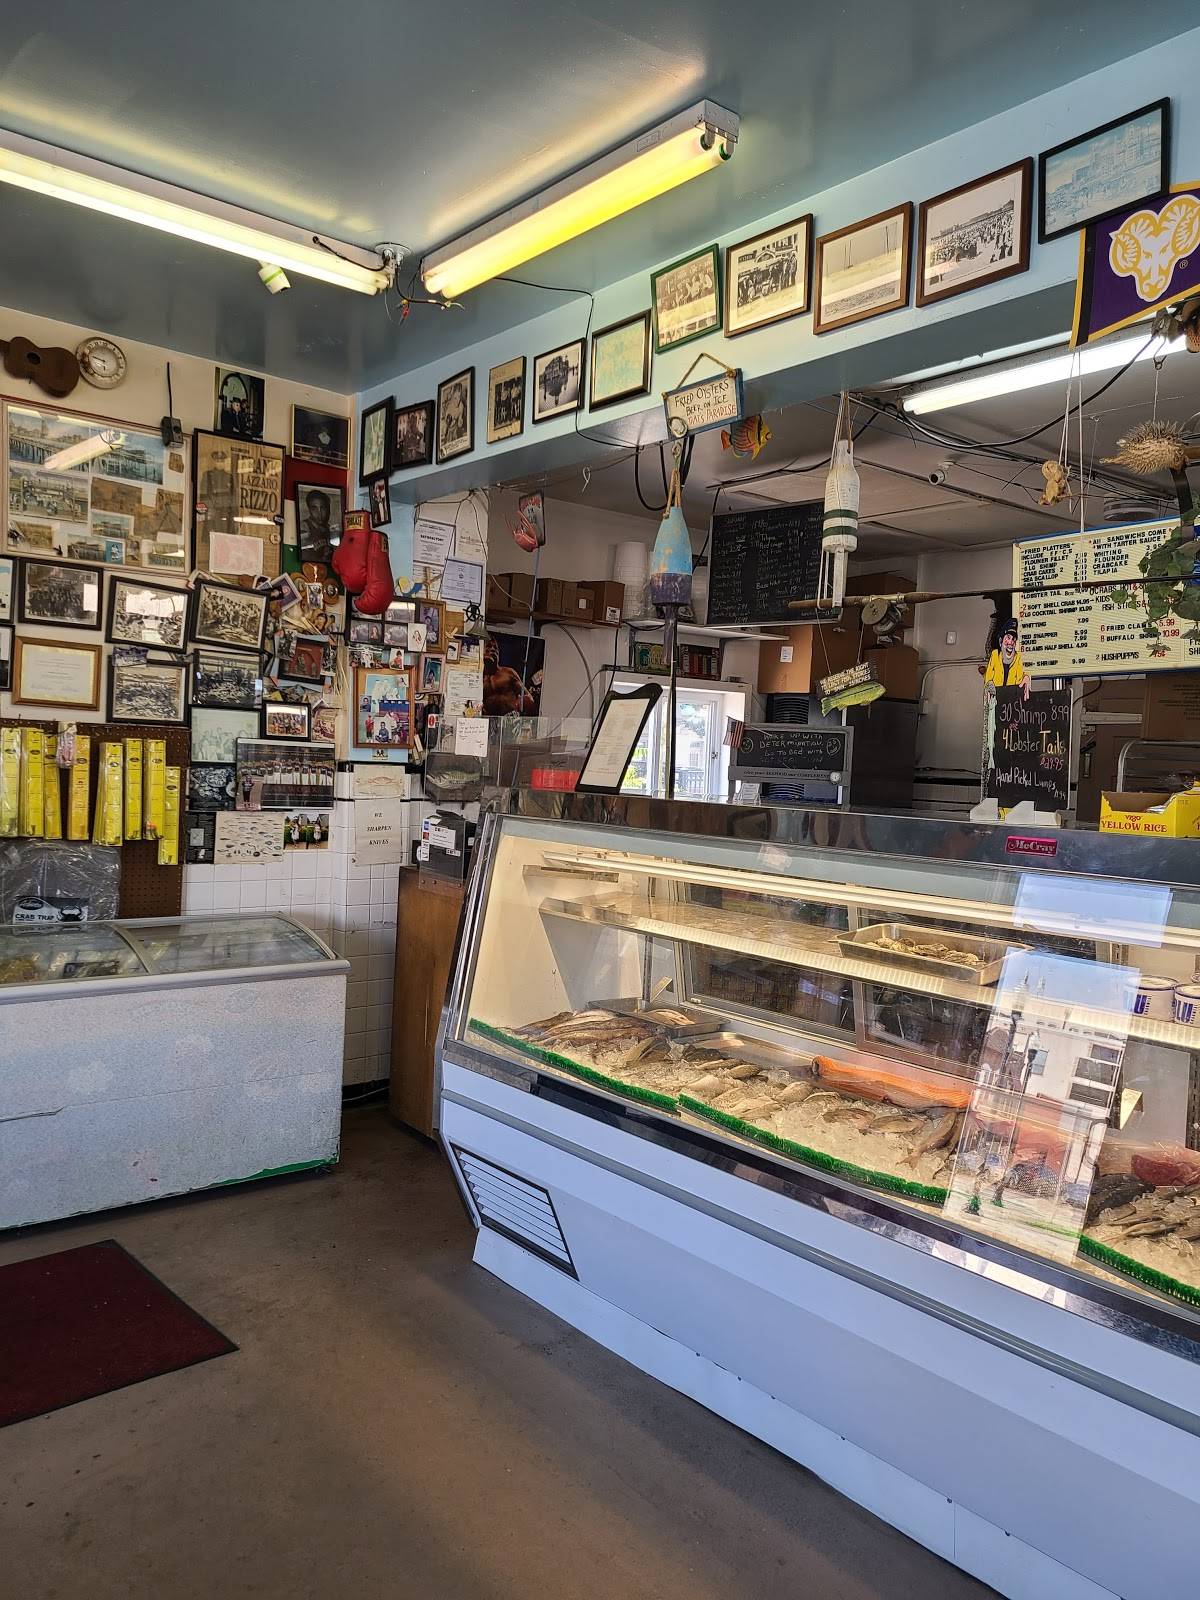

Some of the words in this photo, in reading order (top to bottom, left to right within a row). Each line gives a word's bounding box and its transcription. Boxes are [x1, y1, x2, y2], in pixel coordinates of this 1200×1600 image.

[675, 393, 693, 408] FRIED
[697, 379, 729, 399] OYSTERS
[686, 405, 703, 416] BEER
[714, 395, 728, 406] ICE
[706, 404, 736, 421] PARADISE
[240, 488, 278, 513] RIZZO
[1148, 529, 1166, 537] COME
[1140, 536, 1161, 544] SAUCE
[1094, 549, 1122, 557] WHITING
[1094, 554, 1128, 563] FLOUNDER
[1093, 561, 1128, 569] CRABCAKE
[1024, 591, 1048, 599] LOBSTER
[1096, 595, 1110, 603] KIDS
[1159, 619, 1174, 627] 5.99
[1102, 652, 1139, 661] HUSHPUPPYS
[1000, 703, 1012, 721] 30
[1014, 698, 1047, 732] Shrimp
[1009, 729, 1039, 752] Lobster
[1039, 730, 1066, 755] Tails
[996, 766, 1012, 787] Hand
[1101, 821, 1141, 831] YELLOW
[1144, 824, 1167, 832] RICE
[1015, 840, 1055, 853] McCray
